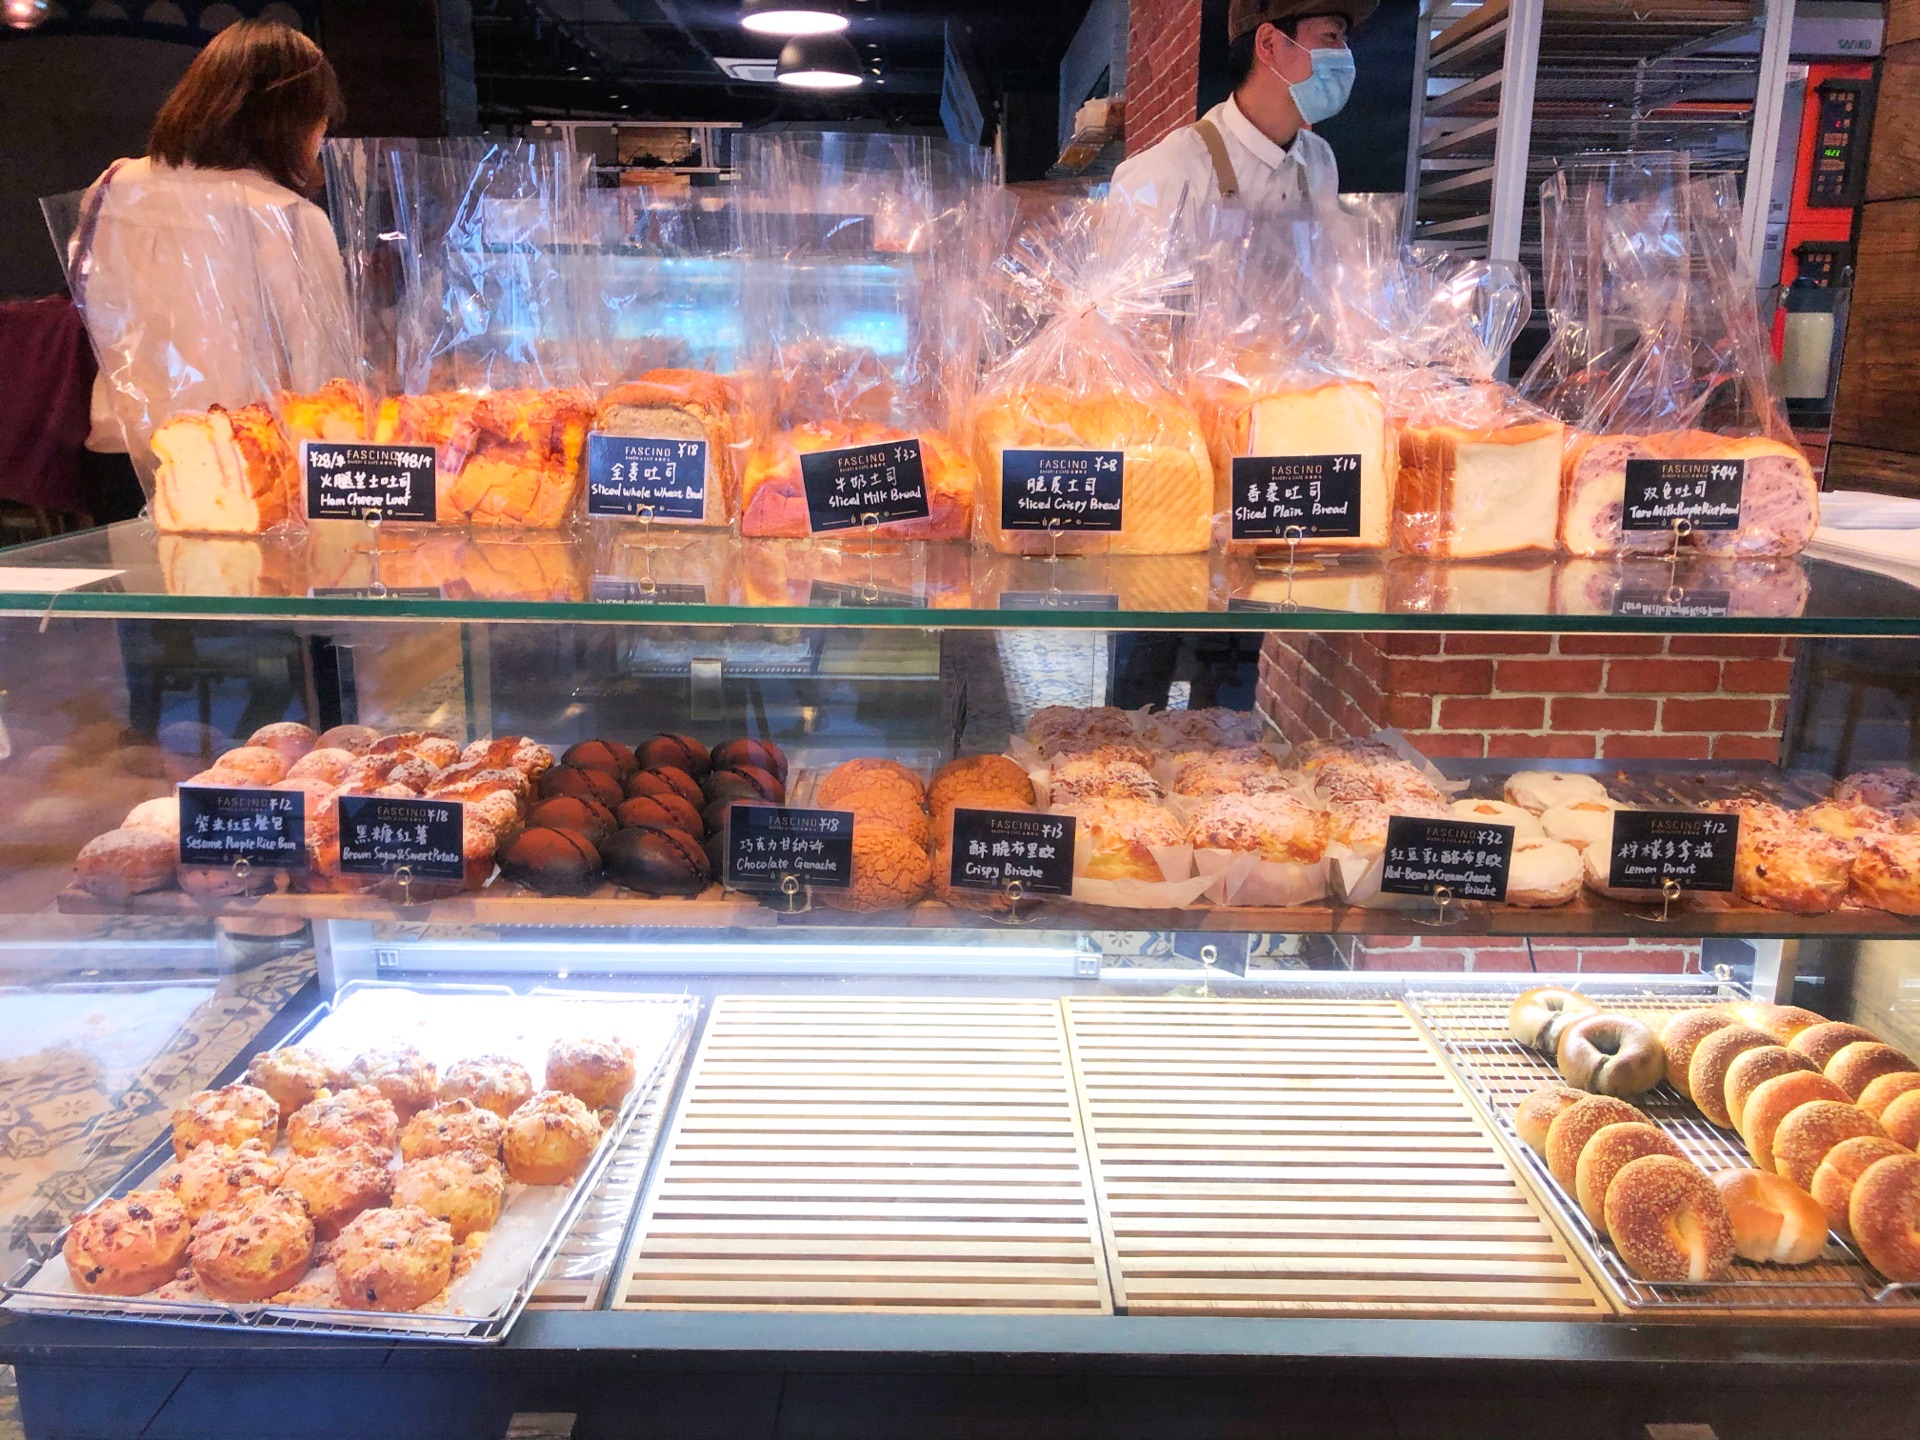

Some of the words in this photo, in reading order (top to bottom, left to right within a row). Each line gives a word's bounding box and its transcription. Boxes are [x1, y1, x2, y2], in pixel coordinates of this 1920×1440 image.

[347, 450, 397, 459] FASCINO
[625, 446, 671, 456] FASCINO
[677, 443, 699, 458] ¥18
[894, 446, 917, 463] ¥32
[837, 452, 886, 468] FASCINO
[1040, 460, 1087, 469] FASCINO
[1094, 456, 1118, 472] ¥28
[1332, 457, 1357, 473] ¥16
[611, 461, 677, 485] 全麦吐司
[1271, 464, 1322, 475] FASCINO
[1662, 464, 1709, 473] FASCINO
[320, 493, 345, 506] Ham
[347, 492, 383, 506] Cheese
[386, 490, 411, 506] Loaf
[591, 483, 622, 497] Sliced
[828, 492, 861, 508] Sliced
[864, 490, 888, 505] Milk
[891, 485, 921, 501] Bread
[1643, 480, 1707, 501] 双色吐司
[1018, 497, 1051, 509] Sliced
[1054, 498, 1087, 513] Crispy
[1090, 498, 1120, 511] Bread
[1235, 506, 1267, 521] Sliced
[1273, 505, 1303, 518] Plain
[1312, 501, 1348, 516] Bread
[1652, 503, 1677, 517] Milk
[377, 806, 426, 817] FASCINO
[427, 809, 449, 823] ¥18
[769, 816, 817, 827] FASCINO
[819, 817, 840, 833] ¥18
[991, 819, 1039, 831] FASCINO
[1651, 820, 1700, 830] FASCINO
[1702, 820, 1728, 835] ¥12
[354, 823, 429, 845] 黑糖红薯
[1041, 822, 1063, 839] ¥13
[1426, 827, 1476, 839] FASCINO
[1477, 830, 1503, 846] ¥32
[739, 836, 825, 855] 巧克力甘纳许
[969, 840, 1055, 859] 酥脆布里欧
[1618, 838, 1714, 863] 柠檬多拿滋
[736, 856, 789, 871] Chocolate
[794, 856, 837, 871] Ganache
[1390, 847, 1502, 868] 红豆乳酪布里欧
[965, 862, 1000, 879] Crispy
[1004, 862, 1043, 878] Brioche
[1625, 864, 1657, 874] Lemon
[1662, 863, 1697, 874] Donut
